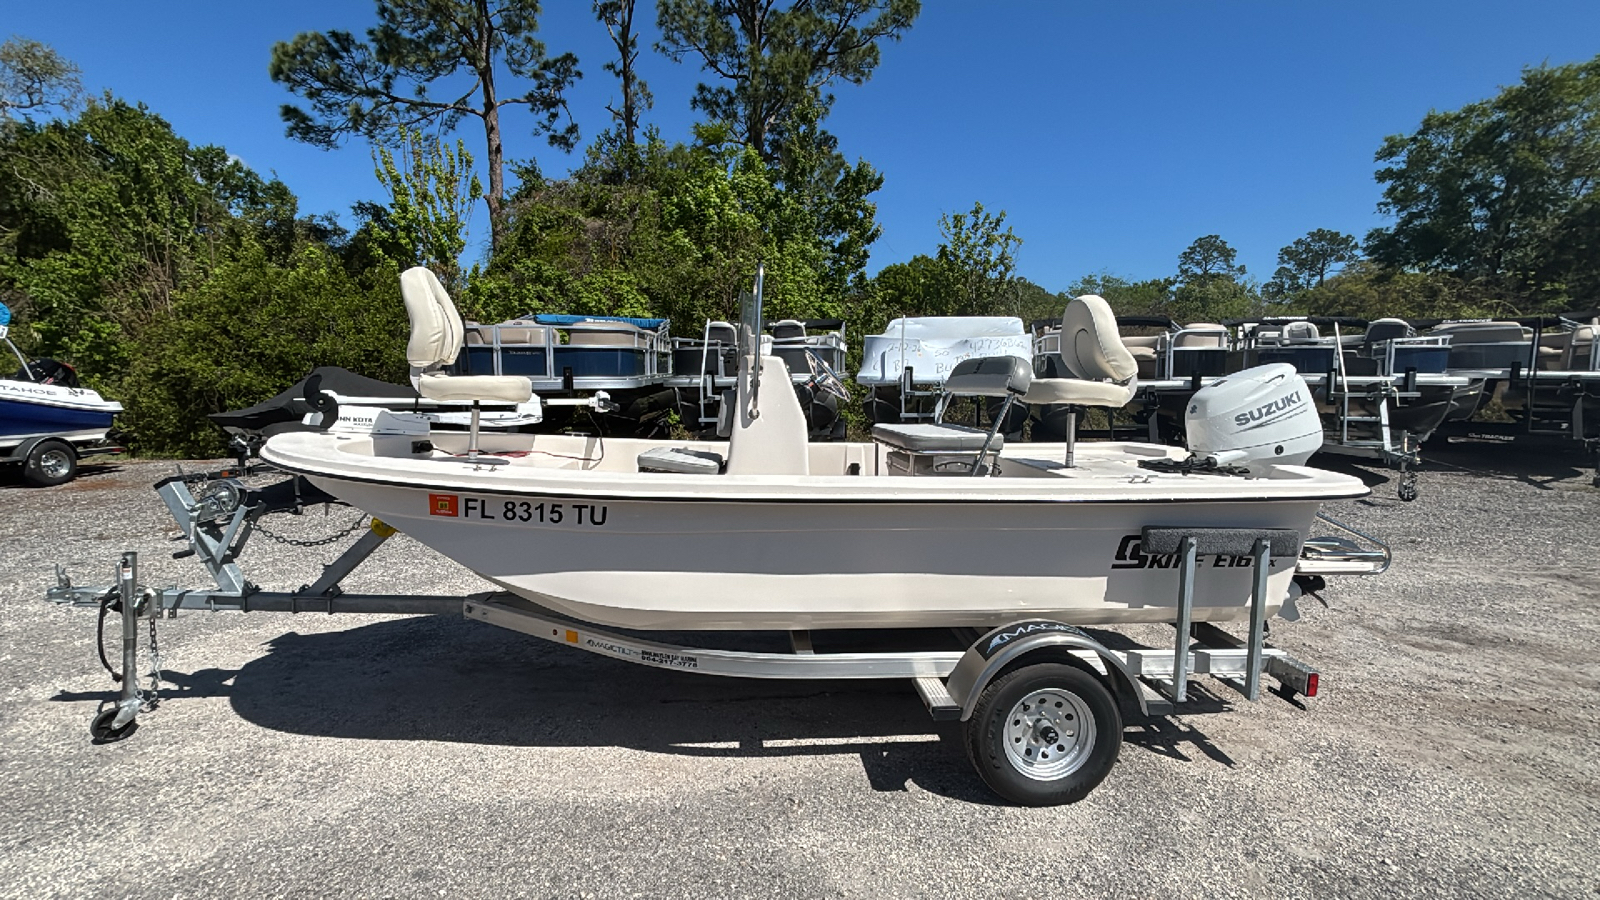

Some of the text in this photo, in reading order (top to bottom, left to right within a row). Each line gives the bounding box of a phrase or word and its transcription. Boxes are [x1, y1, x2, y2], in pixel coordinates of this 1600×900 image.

[1234, 391, 1302, 426] SUZUKI
[464, 498, 607, 525] FL 8315 TU
